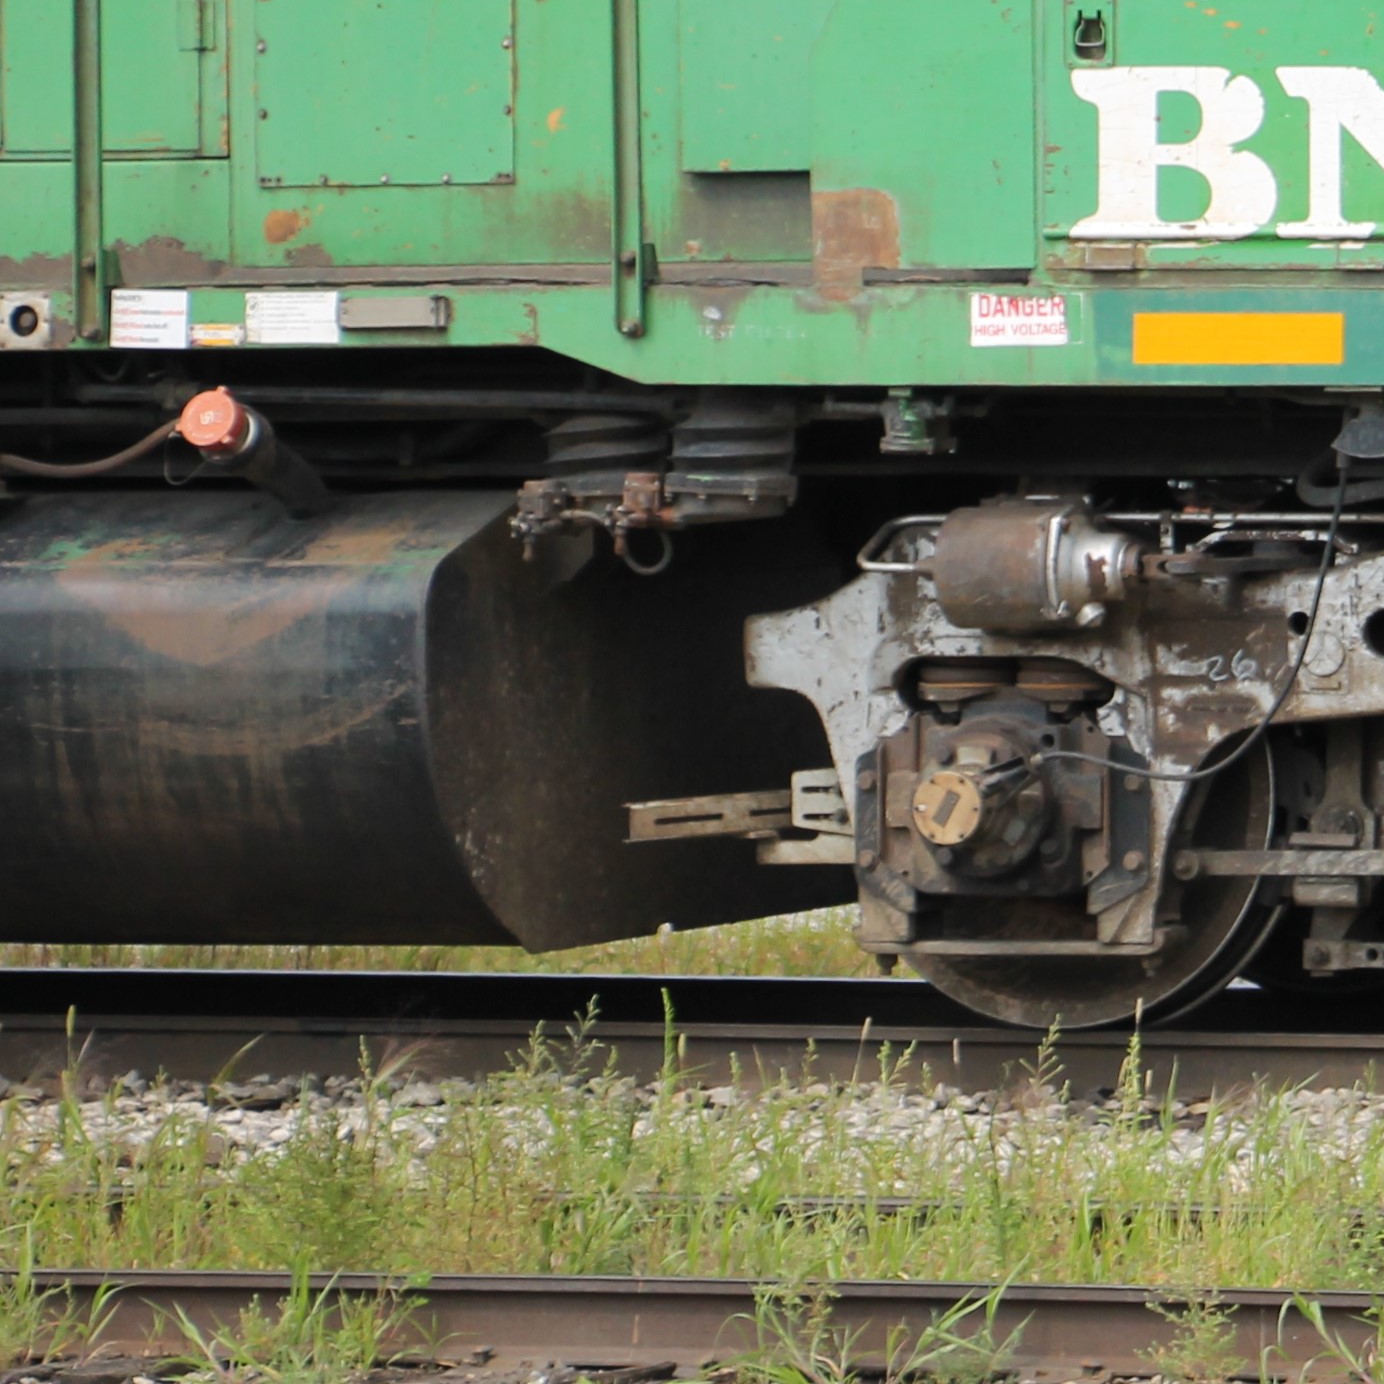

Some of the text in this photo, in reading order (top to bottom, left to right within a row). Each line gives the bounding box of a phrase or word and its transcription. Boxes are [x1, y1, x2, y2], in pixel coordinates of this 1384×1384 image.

[978, 294, 1065, 318] DANGER
[974, 323, 1067, 336] HIGH VOLTAGE
